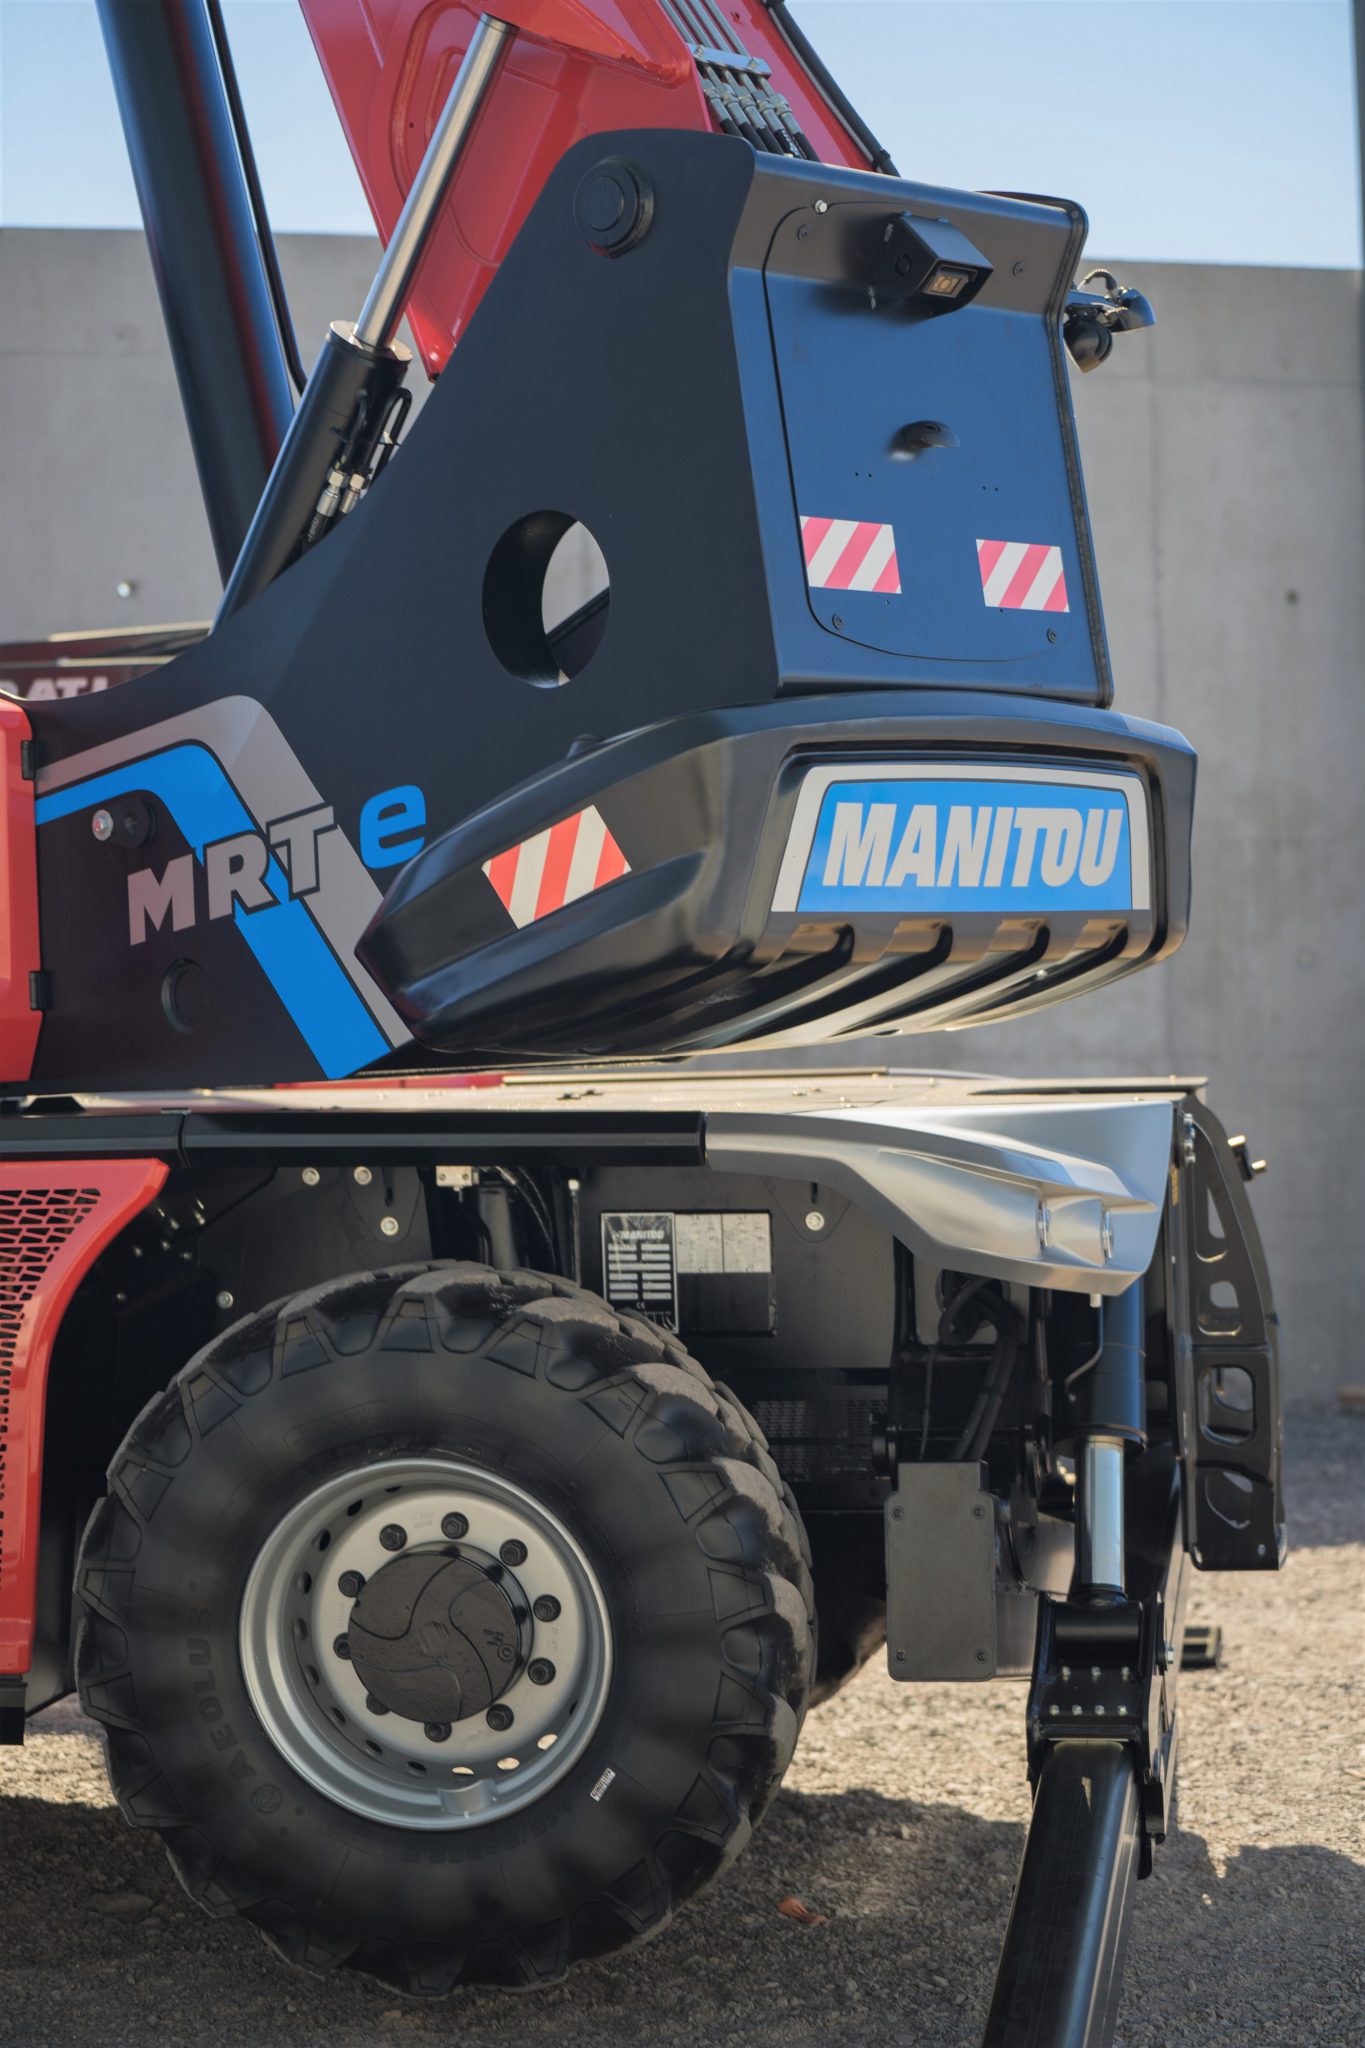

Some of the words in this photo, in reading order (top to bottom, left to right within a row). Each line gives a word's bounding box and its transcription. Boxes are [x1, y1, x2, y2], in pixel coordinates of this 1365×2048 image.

[126, 805, 336, 947] MRT
[822, 801, 1124, 888] MANITOU
[185, 1606, 258, 1780] AEOLUS
